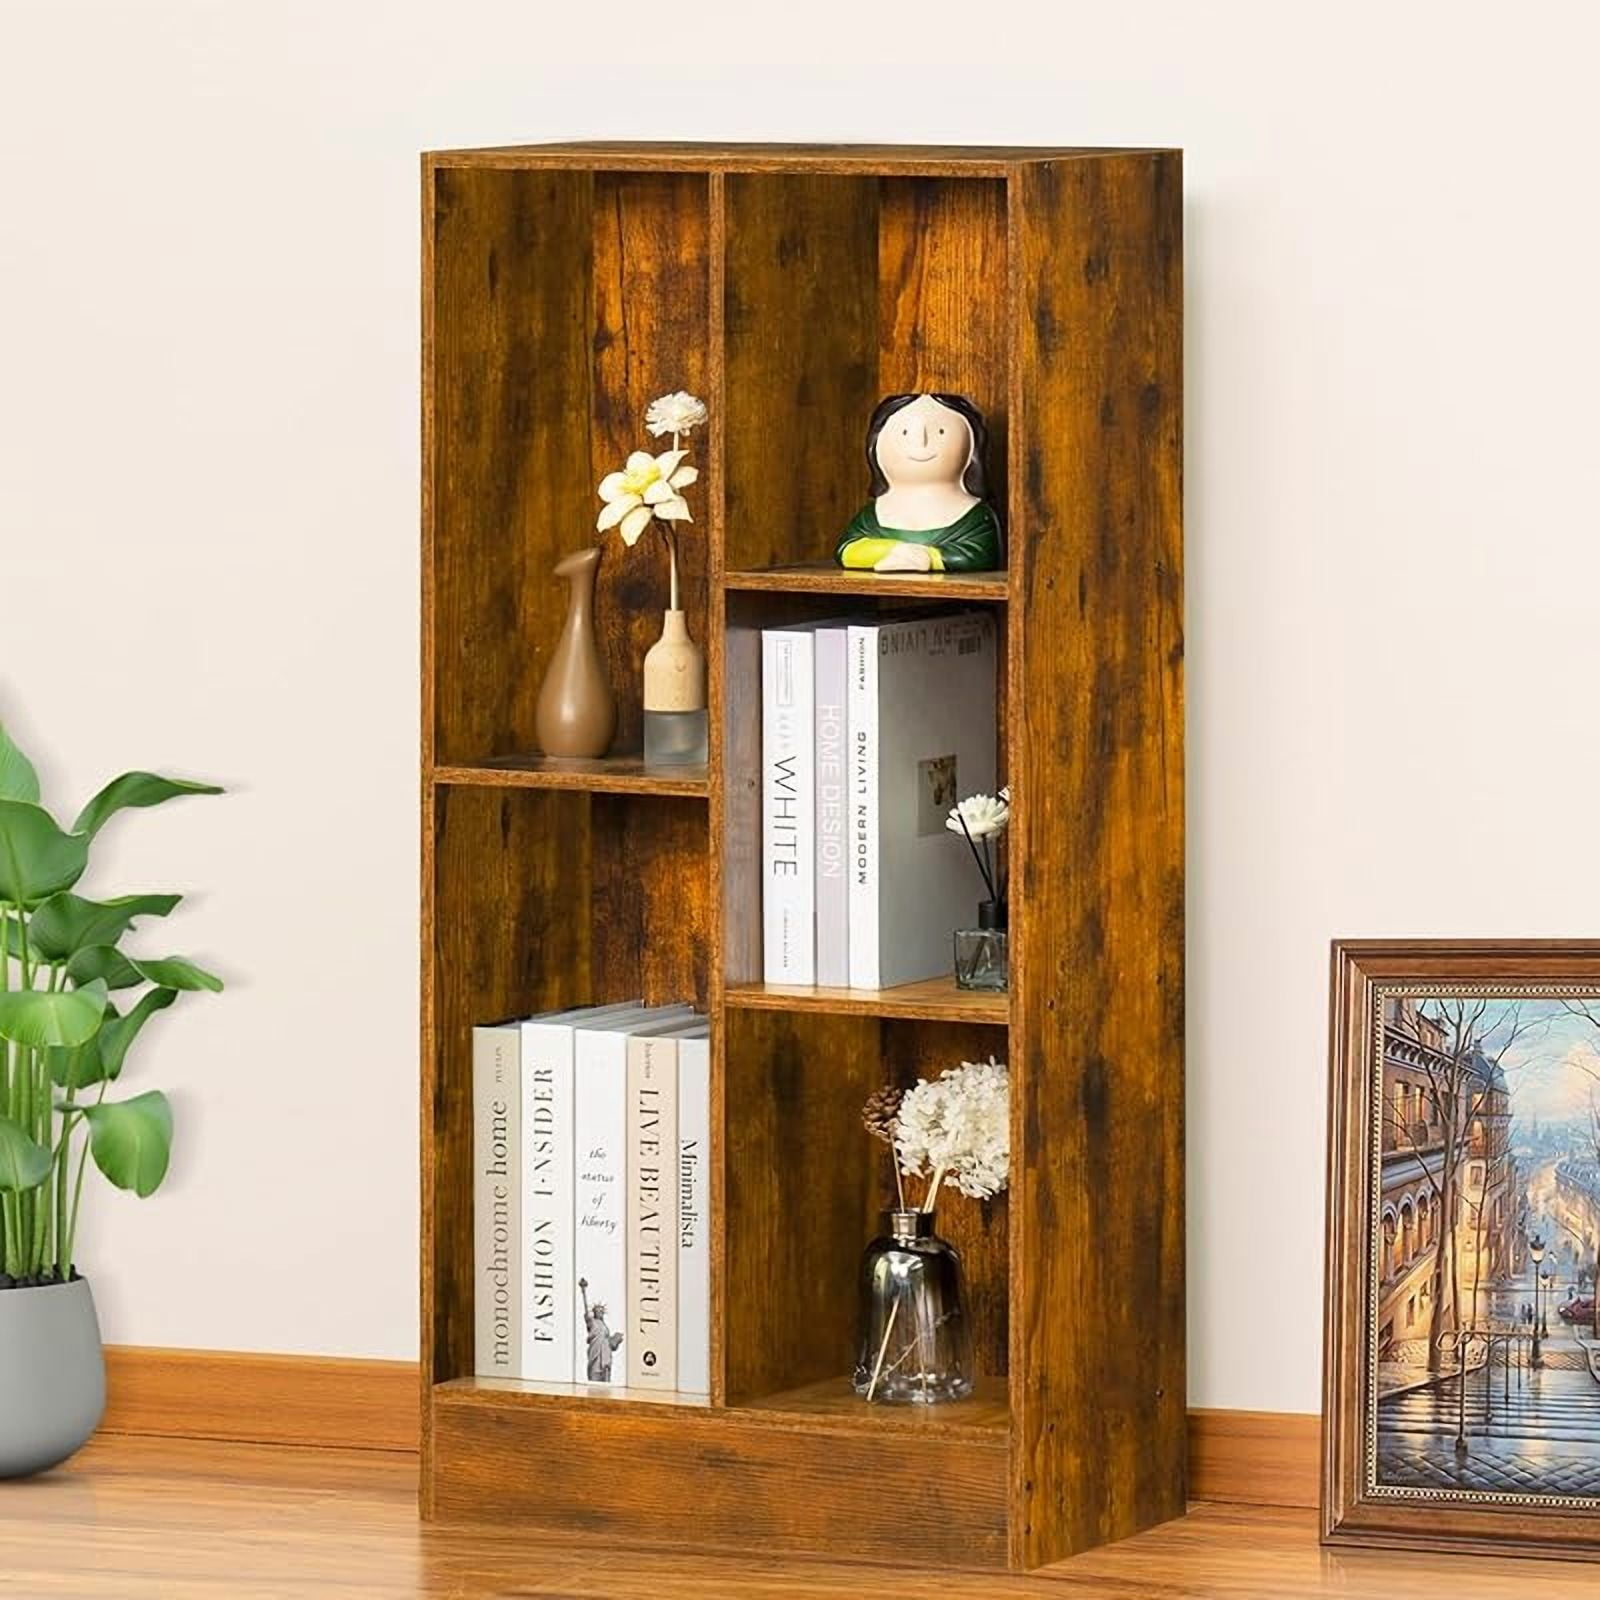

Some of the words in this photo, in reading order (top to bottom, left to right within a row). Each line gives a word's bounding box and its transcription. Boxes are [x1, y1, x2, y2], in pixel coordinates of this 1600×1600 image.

[858, 637, 866, 691] FASHION
[818, 704, 842, 778] HOME
[857, 731, 867, 795] LIVING
[773, 755, 797, 877] WHITE
[857, 803, 867, 885] MODERN
[486, 1100, 508, 1177] home
[589, 1147, 607, 1159] the
[639, 1089, 660, 1157] LIVE
[581, 1215, 616, 1235] liberty
[592, 1192, 606, 1209] of
[680, 1139, 699, 1249] Minimalista
[487, 1185, 509, 1365] monochrome
[533, 1219, 554, 1343] FASHION
[639, 1167, 660, 1335] BEAUTIFUL
